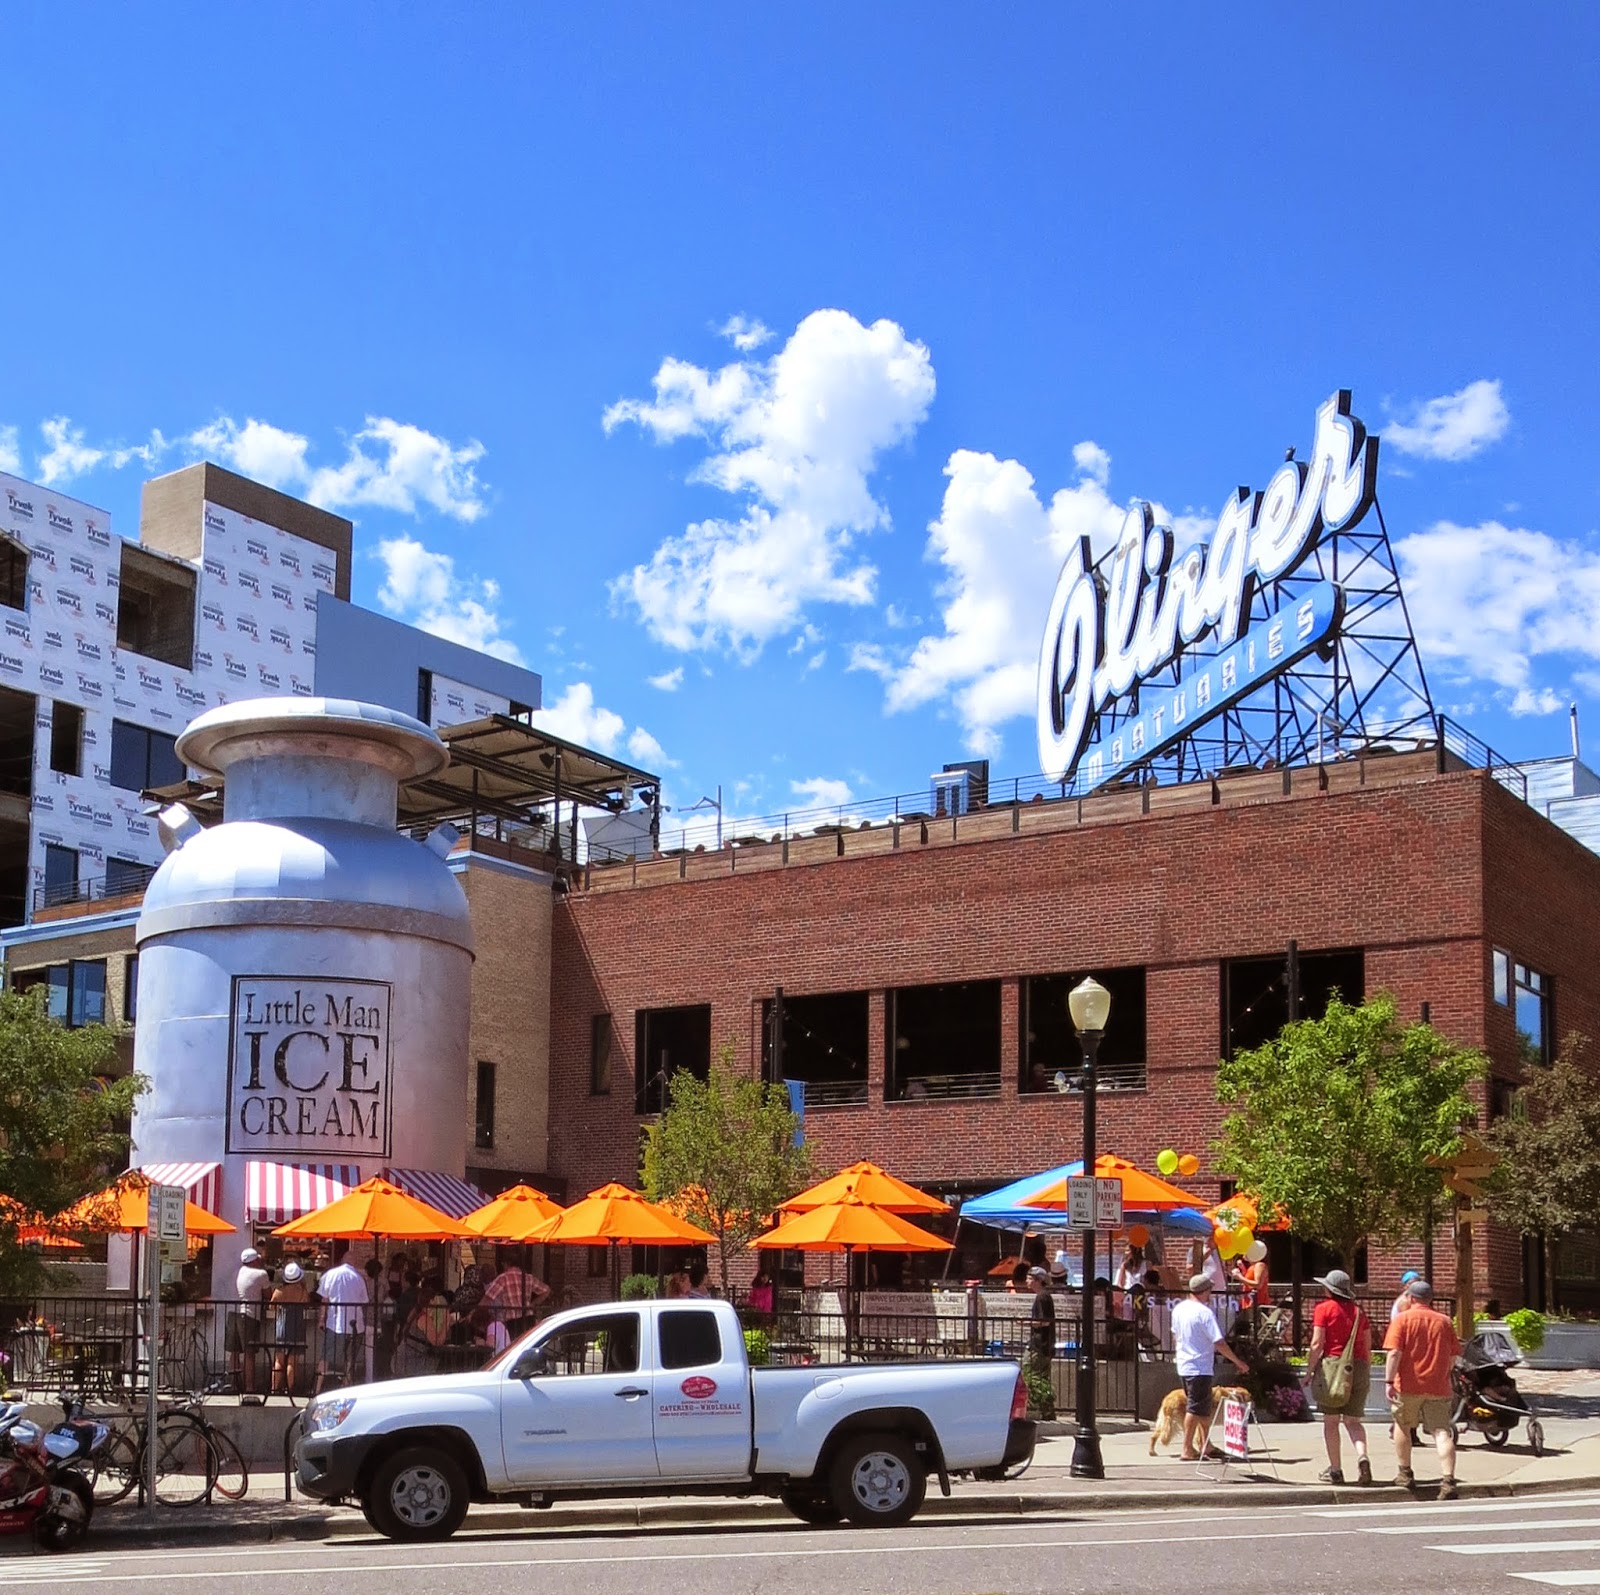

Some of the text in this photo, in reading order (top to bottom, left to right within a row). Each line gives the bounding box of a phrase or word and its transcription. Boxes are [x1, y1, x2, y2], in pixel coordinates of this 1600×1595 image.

[8, 495, 33, 511] Tyvek
[48, 510, 72, 527] Tyvek
[205, 511, 226, 527] Tyvek
[87, 525, 110, 540] Tyvek
[247, 545, 268, 561] Tyvek
[70, 564, 94, 579] Tyvek
[205, 565, 226, 579] Tyvek
[280, 558, 300, 572] Tyvek
[312, 570, 332, 583] Tyvek
[239, 578, 259, 593] Tyvek
[57, 596, 81, 611] Tyvek
[272, 591, 292, 605] Tyvek
[203, 611, 224, 625] Tyvek
[5, 626, 31, 642] Tyvek
[45, 631, 62, 641] vek
[237, 623, 258, 637] Tyvek
[76, 639, 100, 653] Tyvek
[270, 635, 291, 648] Tyvek
[225, 658, 246, 672] Tyvek
[139, 672, 162, 685] Tyvek
[259, 669, 280, 682] Tyvek
[77, 676, 102, 690] Tyvek
[291, 680, 312, 693] Tyvek
[68, 800, 93, 814] Tyvek
[94, 811, 112, 820] yvek
[127, 816, 149, 830] Tyvek
[244, 990, 381, 1030] Little Man
[242, 1031, 380, 1095] ICE
[240, 1096, 380, 1139] CREAM
[1103, 1181, 1114, 1190] NO
[162, 1189, 184, 1199] LOADING
[1097, 1192, 1120, 1202] PARKING
[166, 1201, 179, 1210] ONLY
[167, 1212, 177, 1220] ALL
[1073, 1210, 1089, 1218] TIMES
[165, 1222, 179, 1230] TIMES
[1225, 1421, 1247, 1441] HOUSE
